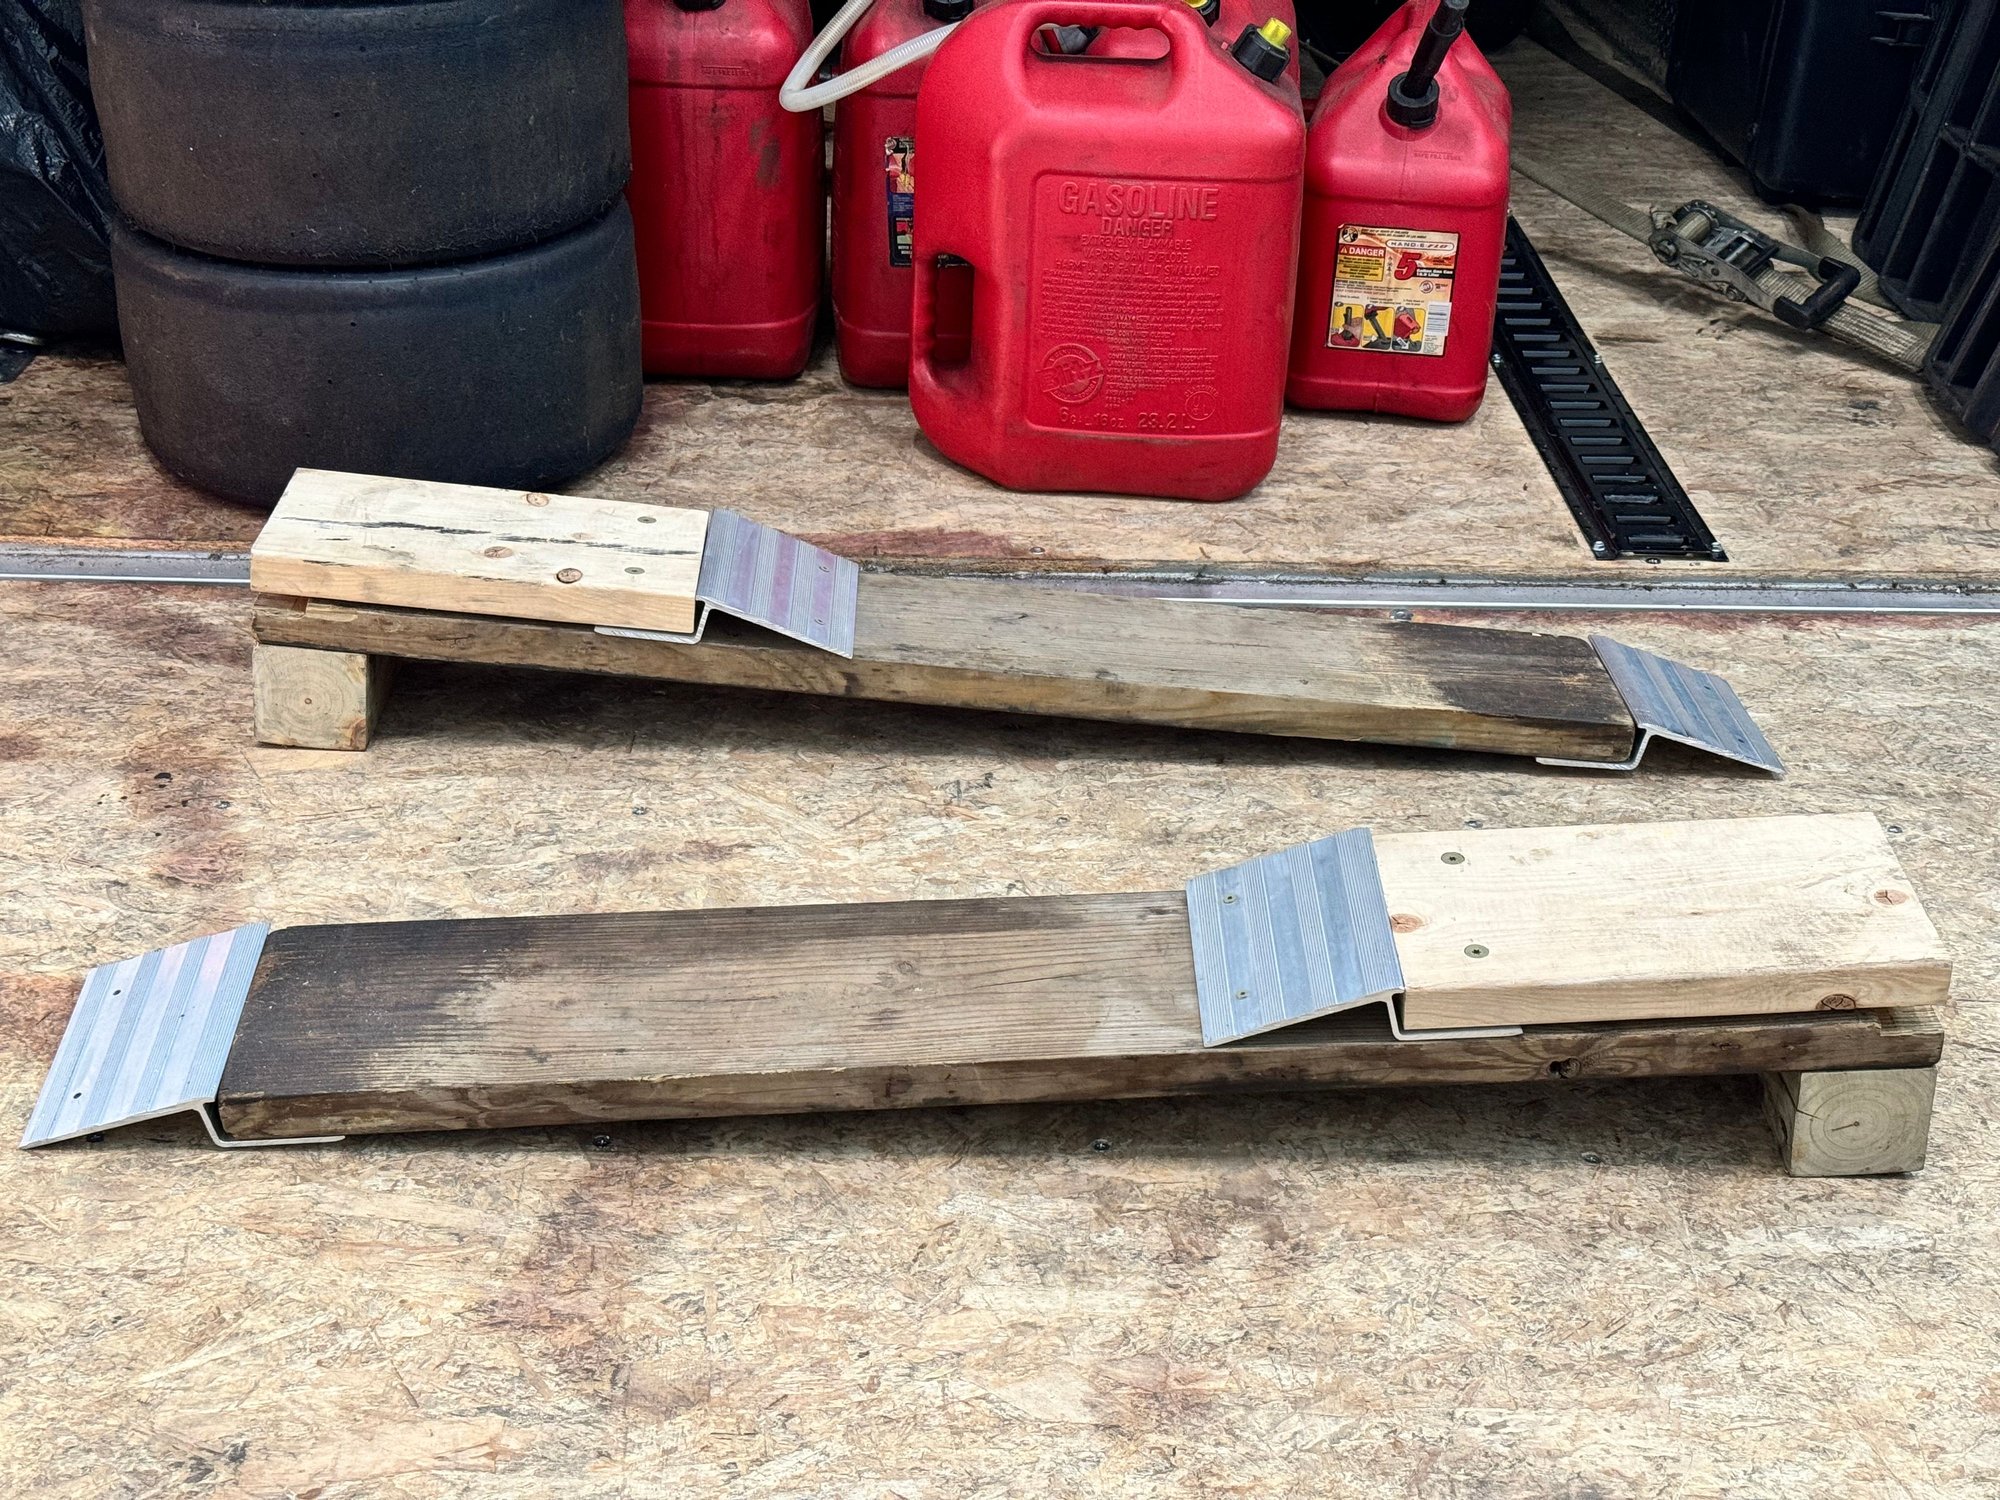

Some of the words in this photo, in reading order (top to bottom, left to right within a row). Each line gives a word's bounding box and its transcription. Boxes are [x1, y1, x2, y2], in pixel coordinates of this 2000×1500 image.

[1058, 180, 1219, 221] GASOLINE
[1101, 216, 1173, 238] DANGER
[1081, 234, 1135, 248] EXTREMELY
[1137, 238, 1193, 251] FLAMMABLE
[1083, 248, 1120, 260] VAPORS
[1124, 250, 1144, 261] CAN
[1148, 252, 1189, 263] EXPLODE
[1349, 247, 1384, 257] DANGER
[1056, 258, 1098, 272] HARMFUL
[1102, 261, 1114, 273] OR
[1119, 262, 1149, 275] FATAL
[1152, 264, 1162, 275] IF
[1164, 265, 1221, 277] SWALLOWED
[1394, 251, 1422, 281] 5
[1059, 406, 1069, 422] 6
